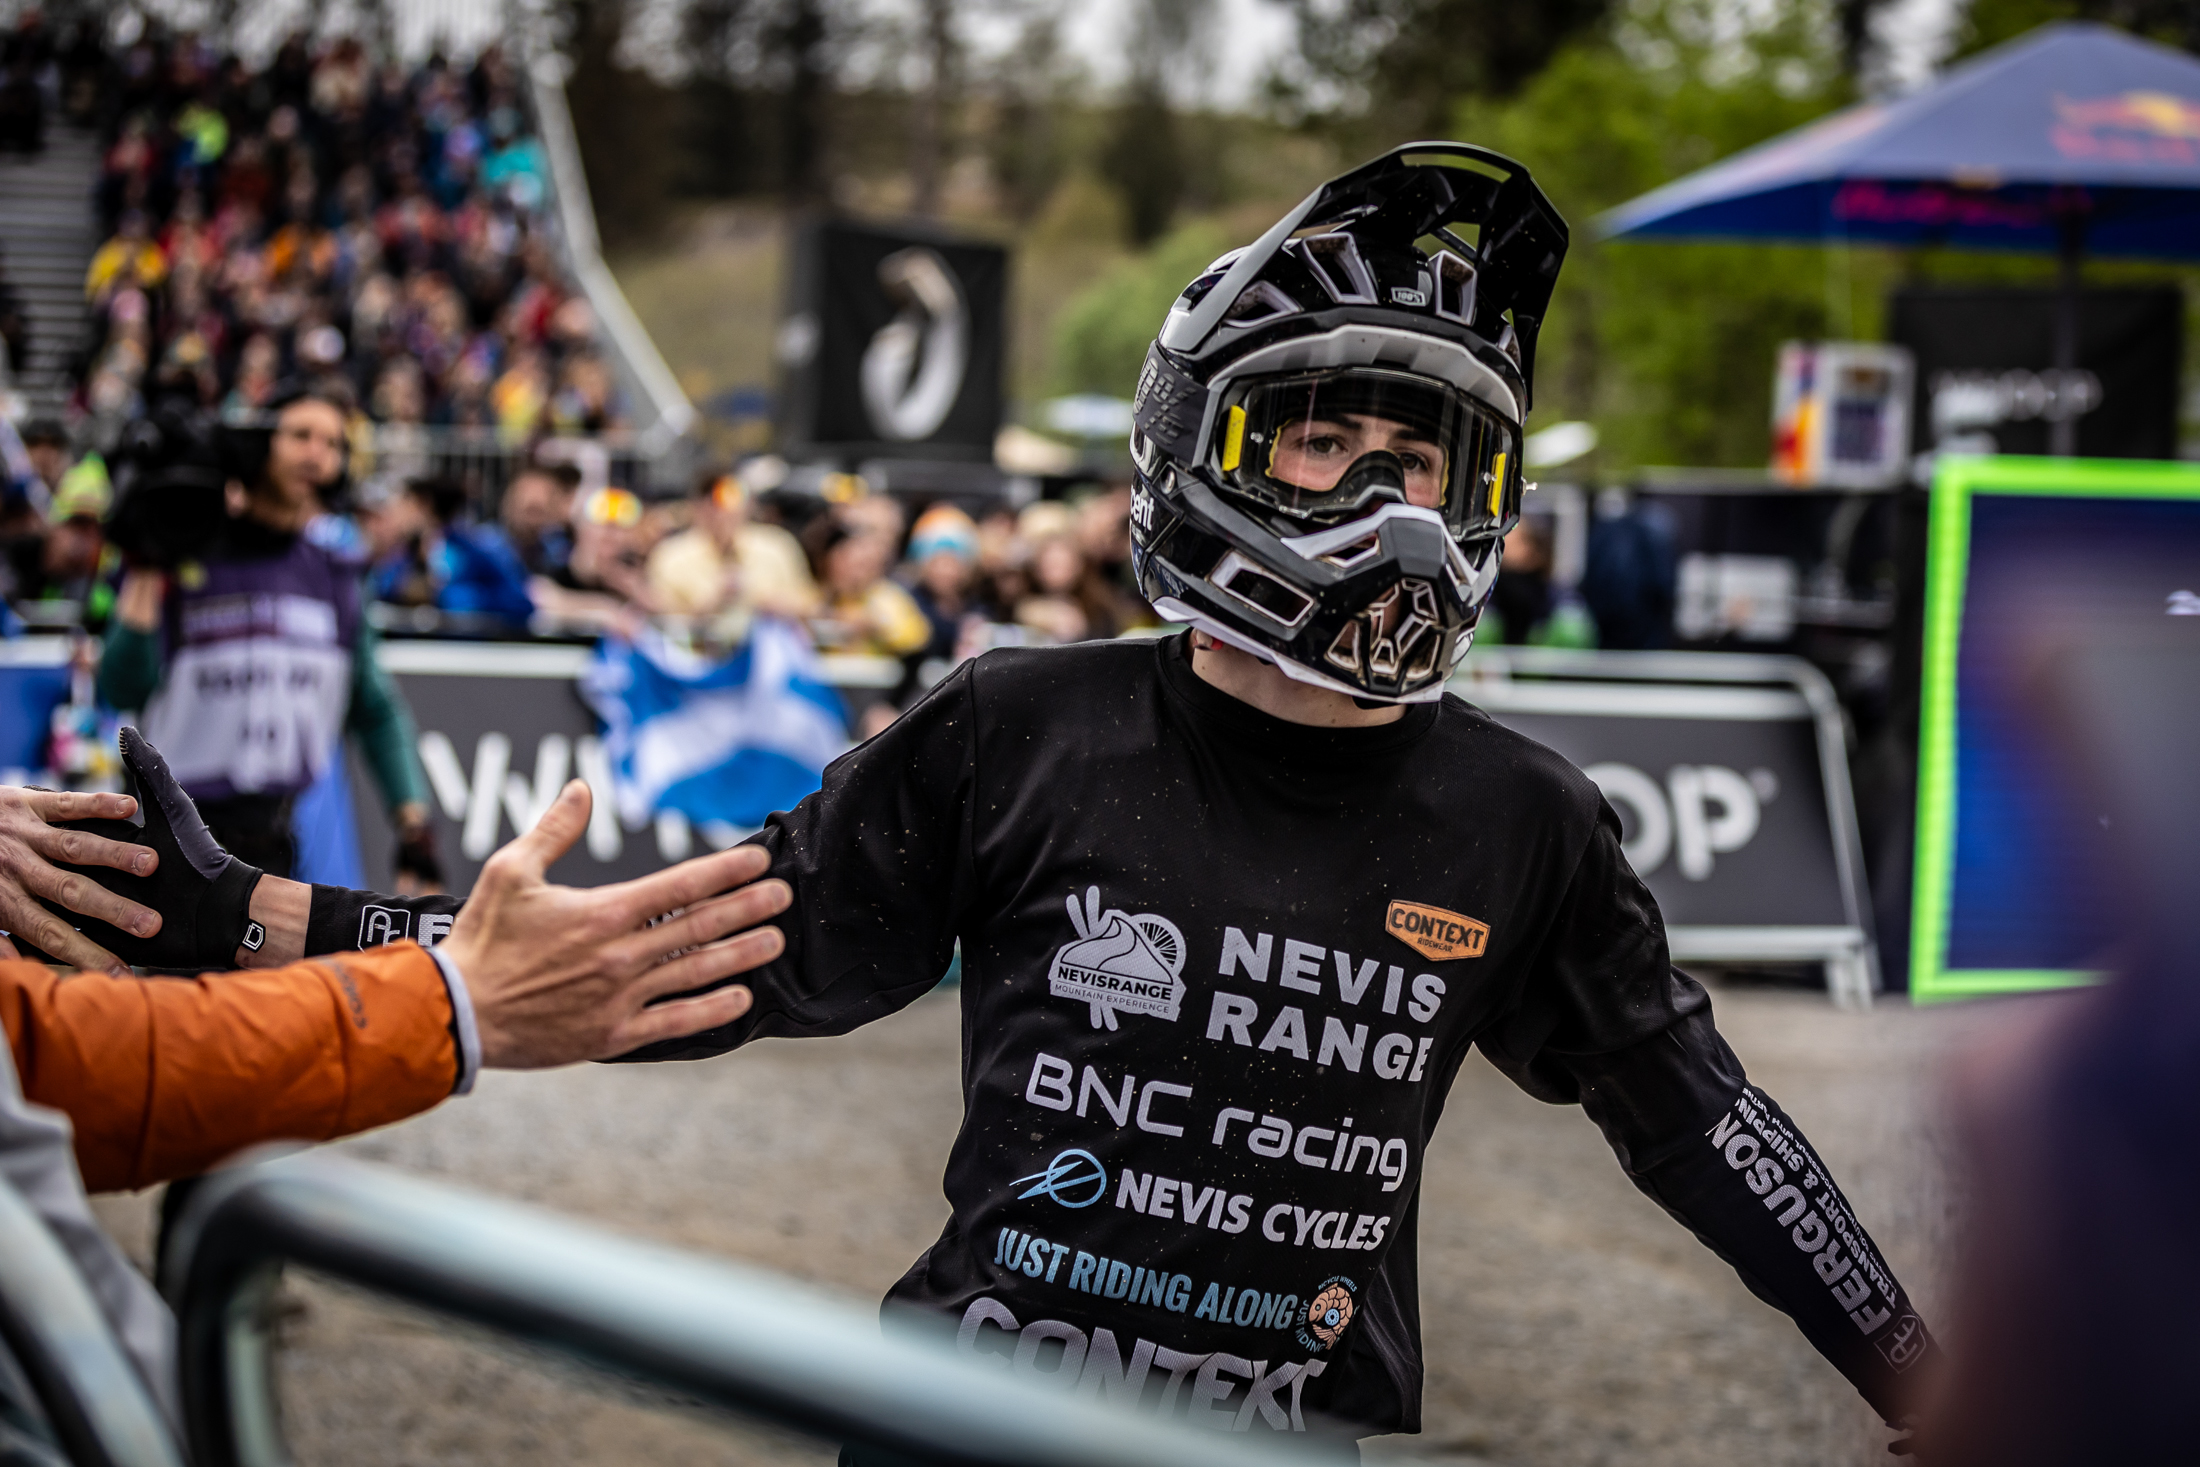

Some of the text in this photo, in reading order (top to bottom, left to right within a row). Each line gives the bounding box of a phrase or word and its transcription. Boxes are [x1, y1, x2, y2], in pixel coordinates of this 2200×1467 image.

[1391, 908, 1485, 950] CONTEXT
[1417, 937, 1454, 953] RIDEWEAR
[1054, 984, 1170, 1014] MOUNTAIN EXPERIENCE
[1057, 966, 1173, 1001] NEVISRANGE
[1218, 926, 1447, 1024] NEVIS
[1206, 990, 1434, 1082] RANGE
[1026, 1052, 1408, 1192] BNC racing
[1115, 1168, 1391, 1251] NEVIS CYCLES
[1704, 1111, 1892, 1336] FERGUSON
[1735, 1097, 1897, 1310] TRANSPORT & SHIPPIN
[994, 1227, 1070, 1283] JUST
[1068, 1250, 1193, 1313] RIDING
[1194, 1281, 1299, 1330] ALONG
[1296, 1299, 1310, 1326] JUST
[1340, 1275, 1358, 1293] WHEELS
[956, 1297, 1328, 1433] CONTEXT
